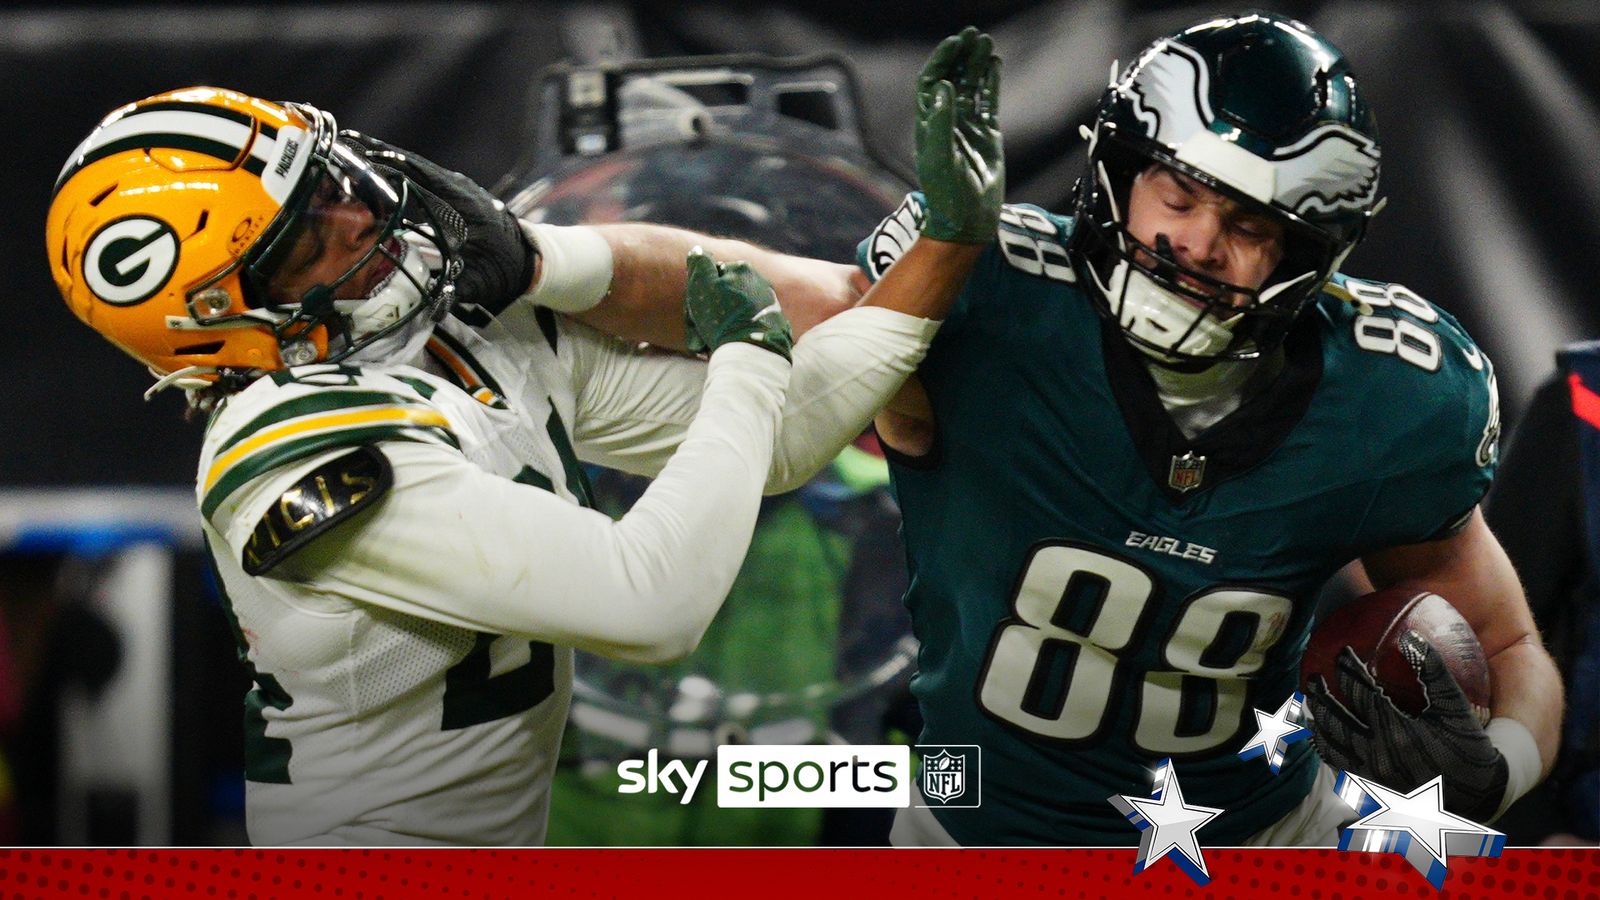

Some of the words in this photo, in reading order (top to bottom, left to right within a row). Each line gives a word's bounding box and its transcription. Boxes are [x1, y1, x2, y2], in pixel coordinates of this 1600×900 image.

[274, 138, 299, 178] PACKERS
[84, 218, 179, 304] G
[1344, 279, 1441, 372] 88
[1125, 530, 1218, 564] EAGLES
[979, 545, 1294, 754] 88
